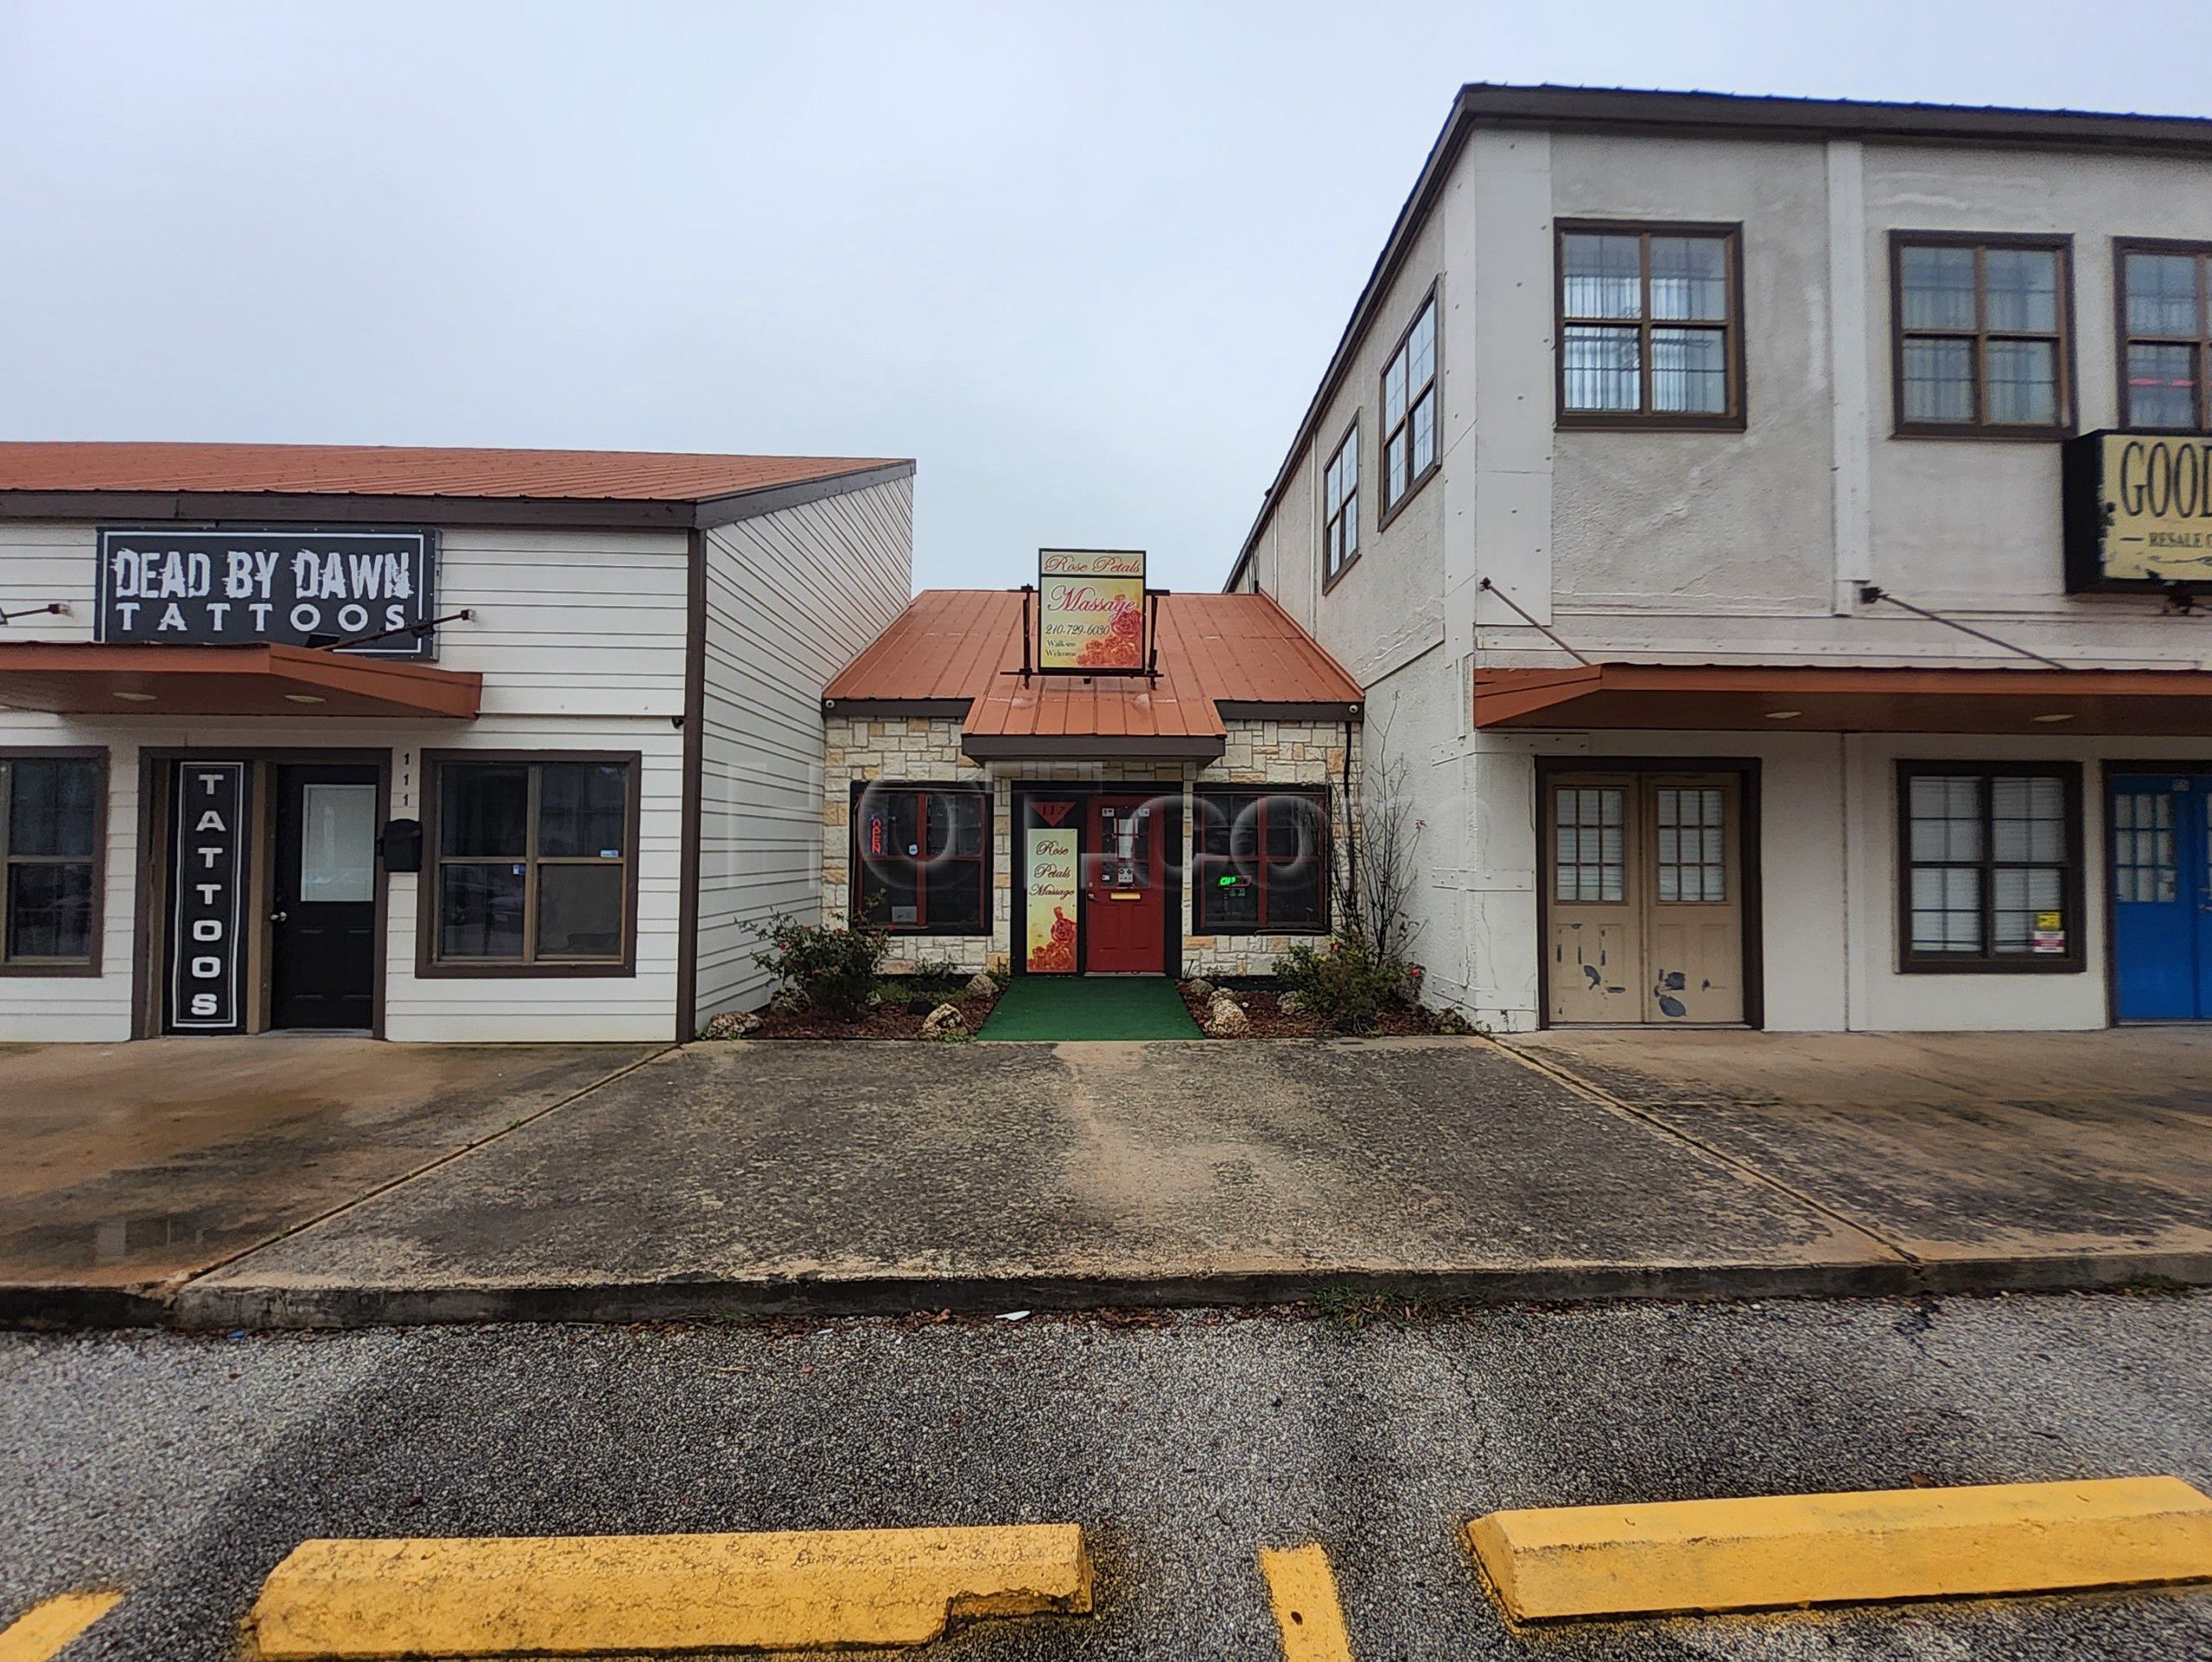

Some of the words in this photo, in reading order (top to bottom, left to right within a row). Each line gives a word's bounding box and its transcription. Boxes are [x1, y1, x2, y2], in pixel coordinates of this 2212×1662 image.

[110, 547, 211, 599] DEAD
[222, 550, 280, 600] BY
[289, 549, 415, 601] DAWN
[1045, 554, 1088, 573] Rose
[1091, 556, 1141, 573] Petals
[115, 602, 406, 632] TATTOOS
[1047, 585, 1135, 622] Massage
[871, 818, 882, 856] OPEN
[1035, 840, 1069, 856] Rose
[1033, 863, 1071, 879] Petals
[190, 774, 227, 1016] TATTOOS
[1029, 884, 1075, 900] Massage
